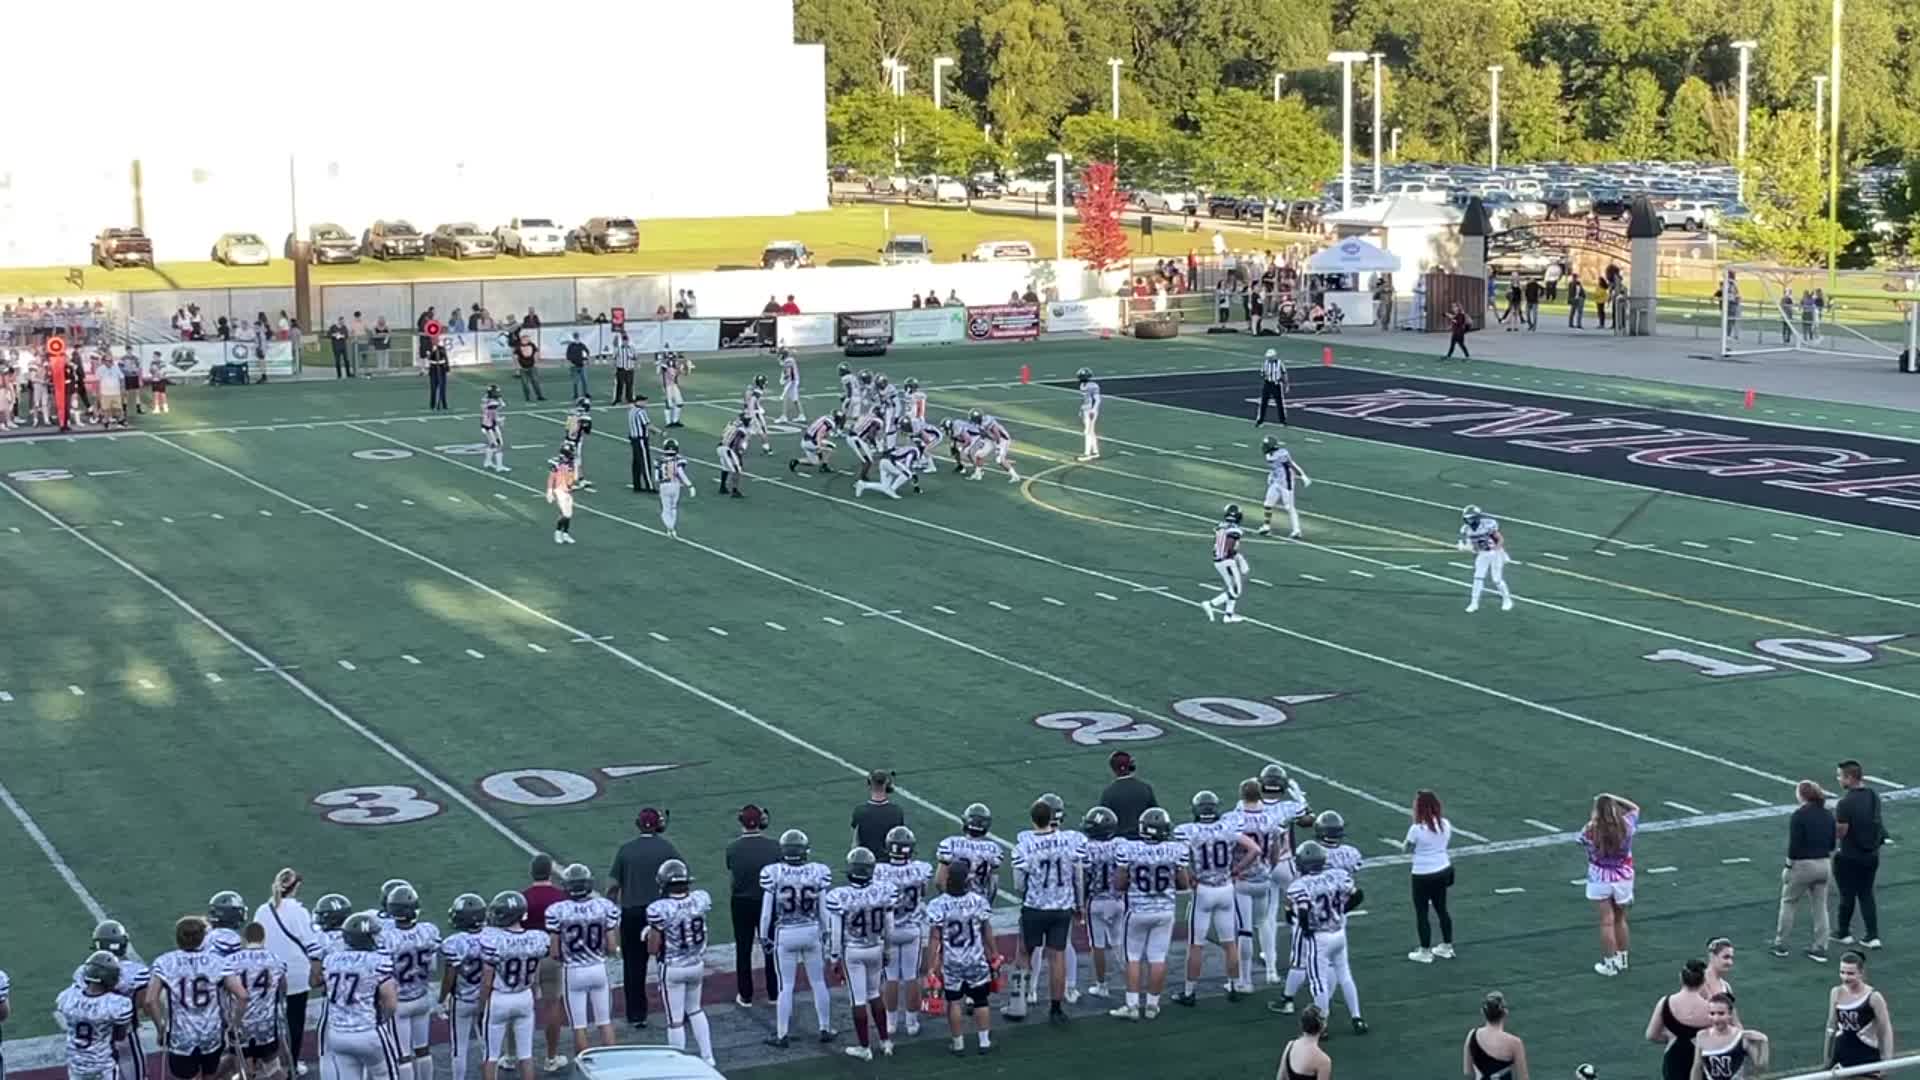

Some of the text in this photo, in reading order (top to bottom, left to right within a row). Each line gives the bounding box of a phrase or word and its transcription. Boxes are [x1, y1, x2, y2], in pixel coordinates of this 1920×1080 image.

[1301, 389, 1920, 510] KNIG
[1035, 697, 1287, 745] 20
[313, 769, 599, 825] 30
[1200, 841, 1230, 871] 10
[1040, 857, 1064, 889] 71
[1135, 865, 1170, 893] 66
[780, 886, 816, 914] 36
[361, 920, 370, 932] N
[680, 917, 705, 949] 18
[852, 907, 884, 937] 40
[949, 920, 975, 948] 21
[567, 924, 602, 952] 20
[399, 950, 431, 983] 25
[179, 974, 211, 1009] 16
[241, 968, 270, 999] 14
[328, 973, 359, 1005] 77
[76, 1021, 93, 1049] 9
[1709, 1055, 1732, 1077] N
